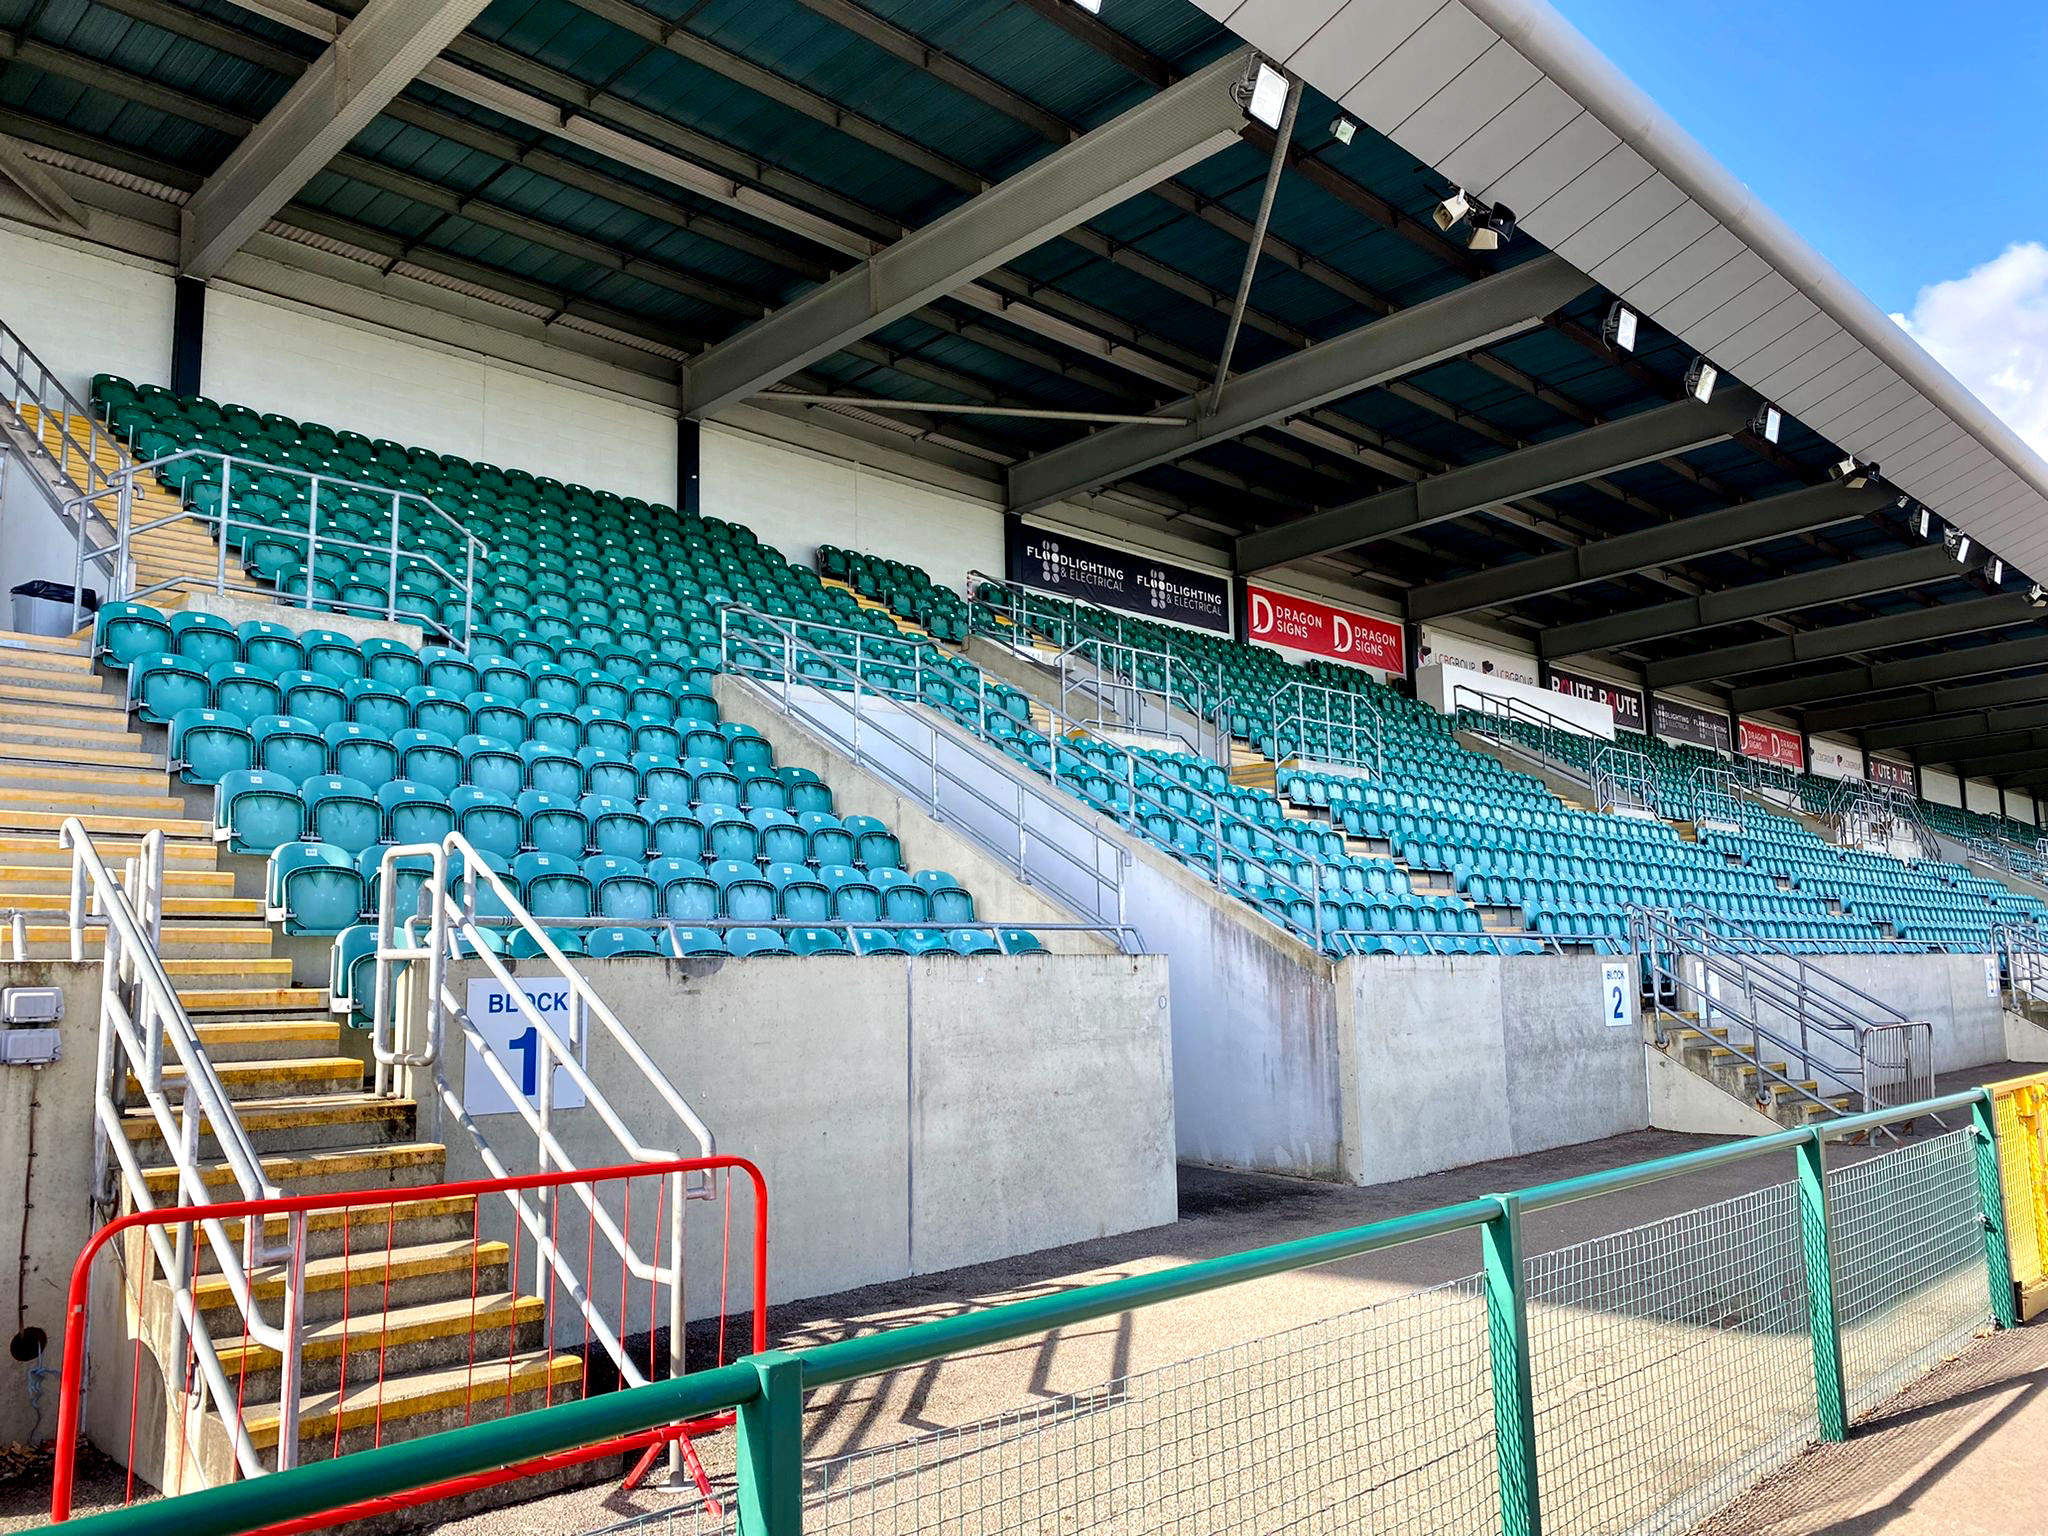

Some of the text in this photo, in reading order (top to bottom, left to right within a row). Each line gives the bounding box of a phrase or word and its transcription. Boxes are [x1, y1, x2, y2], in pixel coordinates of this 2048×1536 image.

[1026, 545, 1124, 580] FLOODLIGHTING
[1060, 566, 1124, 592] & ELECTRICAL
[1137, 575, 1222, 605] FLOODLIGHTING
[1166, 593, 1222, 616] & ELECTRICAL
[1276, 606, 1322, 628] DRAGON
[1277, 620, 1308, 638] SIGNS
[1354, 626, 1396, 647] DRAGON
[1355, 640, 1383, 656] SIGNS
[1613, 986, 1623, 1019] 2
[509, 1027, 537, 1095] 1
